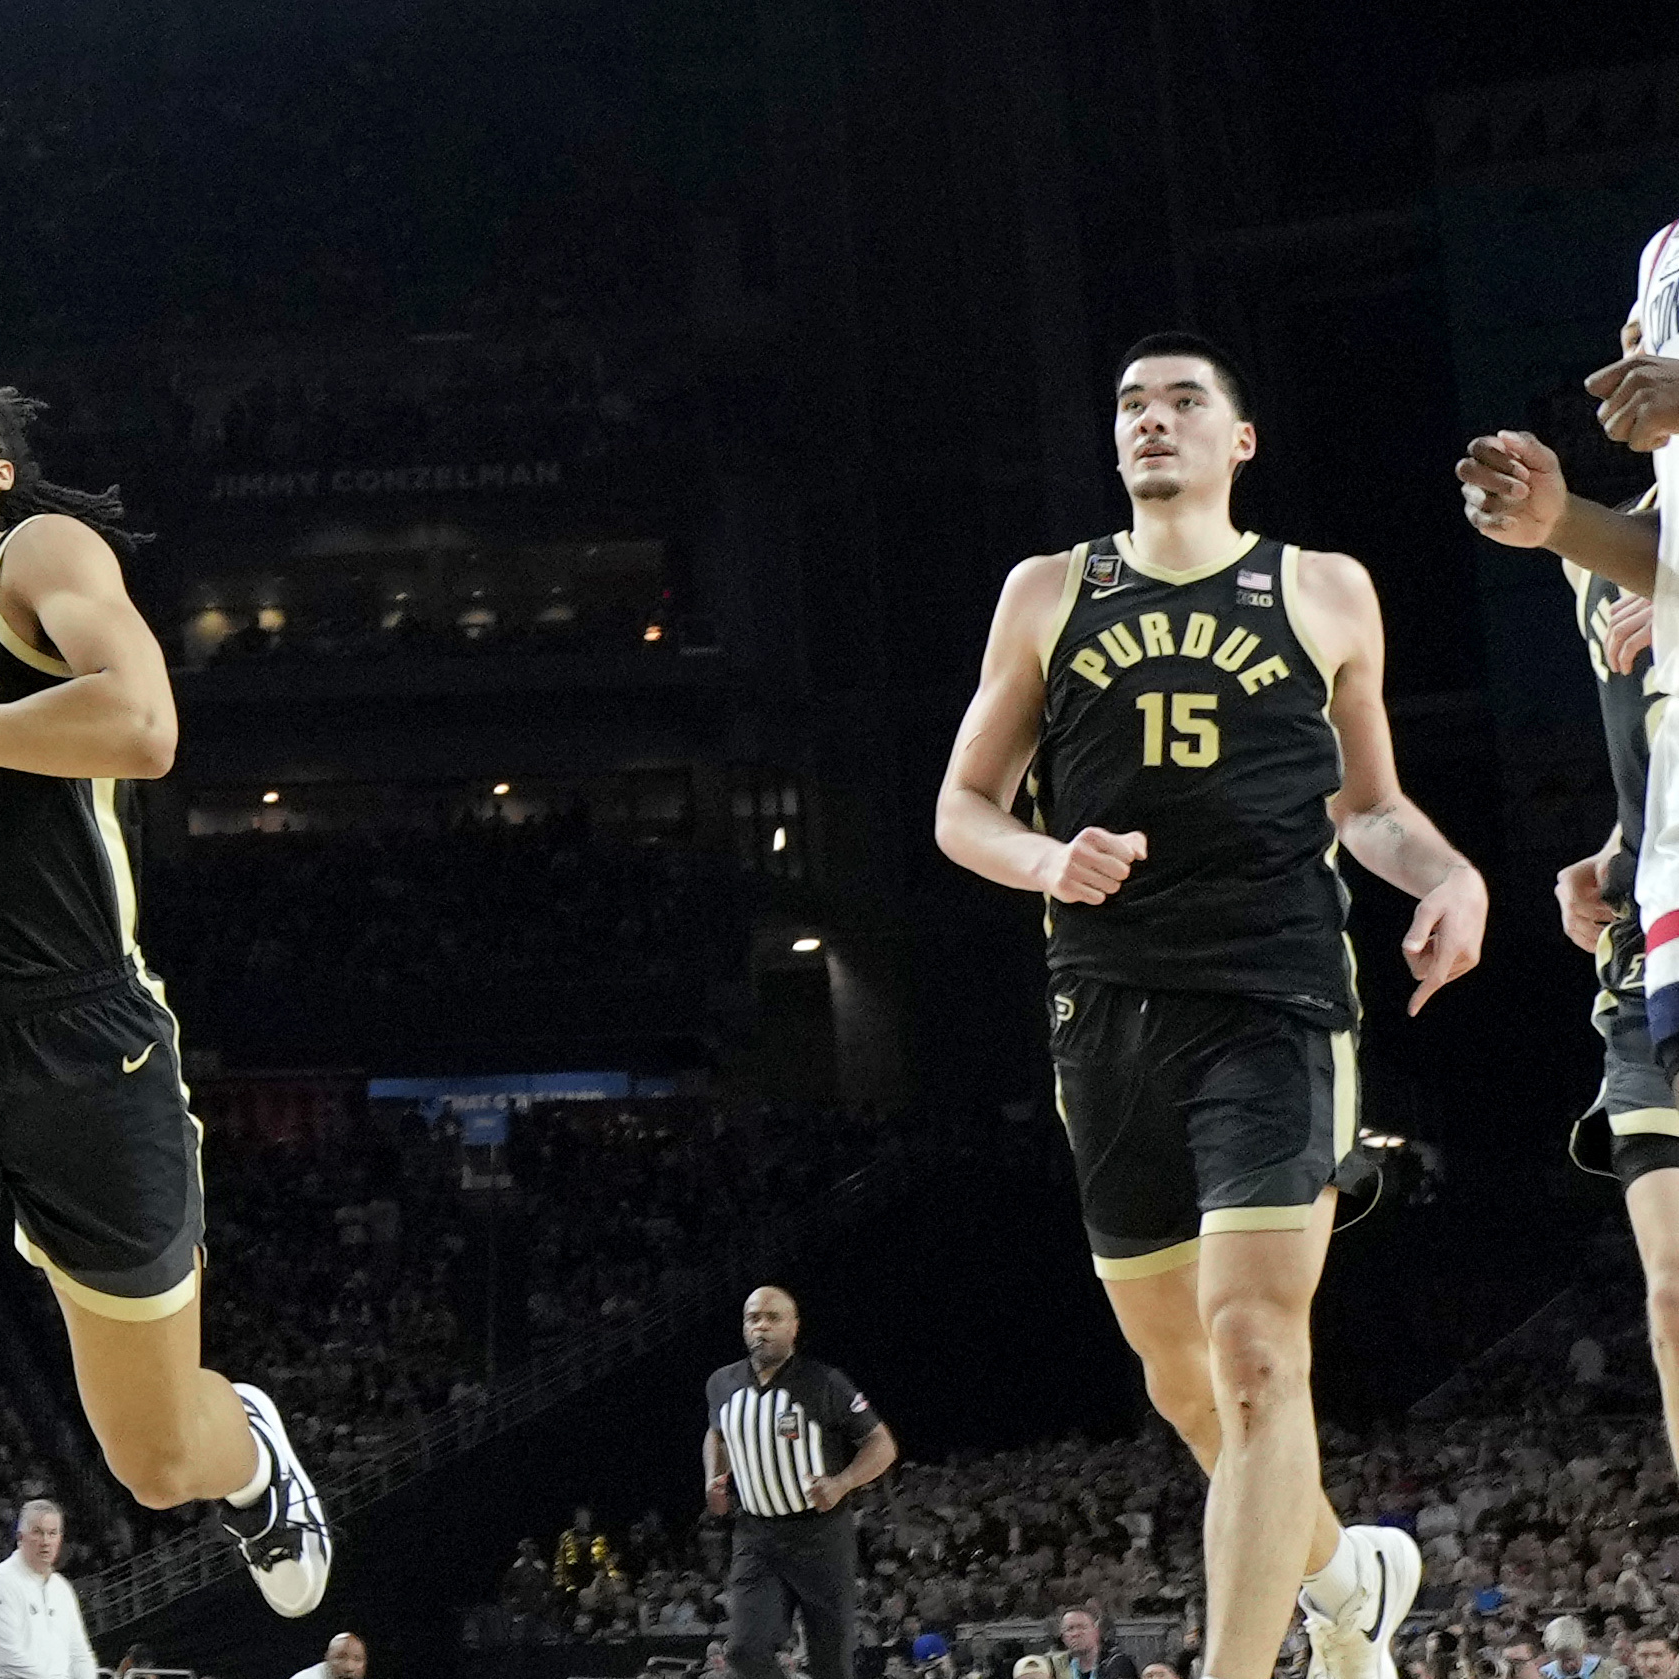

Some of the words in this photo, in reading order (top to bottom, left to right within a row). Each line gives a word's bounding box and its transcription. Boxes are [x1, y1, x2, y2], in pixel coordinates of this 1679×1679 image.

[207, 469, 321, 501] JIMMY
[330, 461, 562, 494] CONZELMAN
[1069, 610, 1292, 698] PURDUE
[1135, 689, 1221, 770] 15
